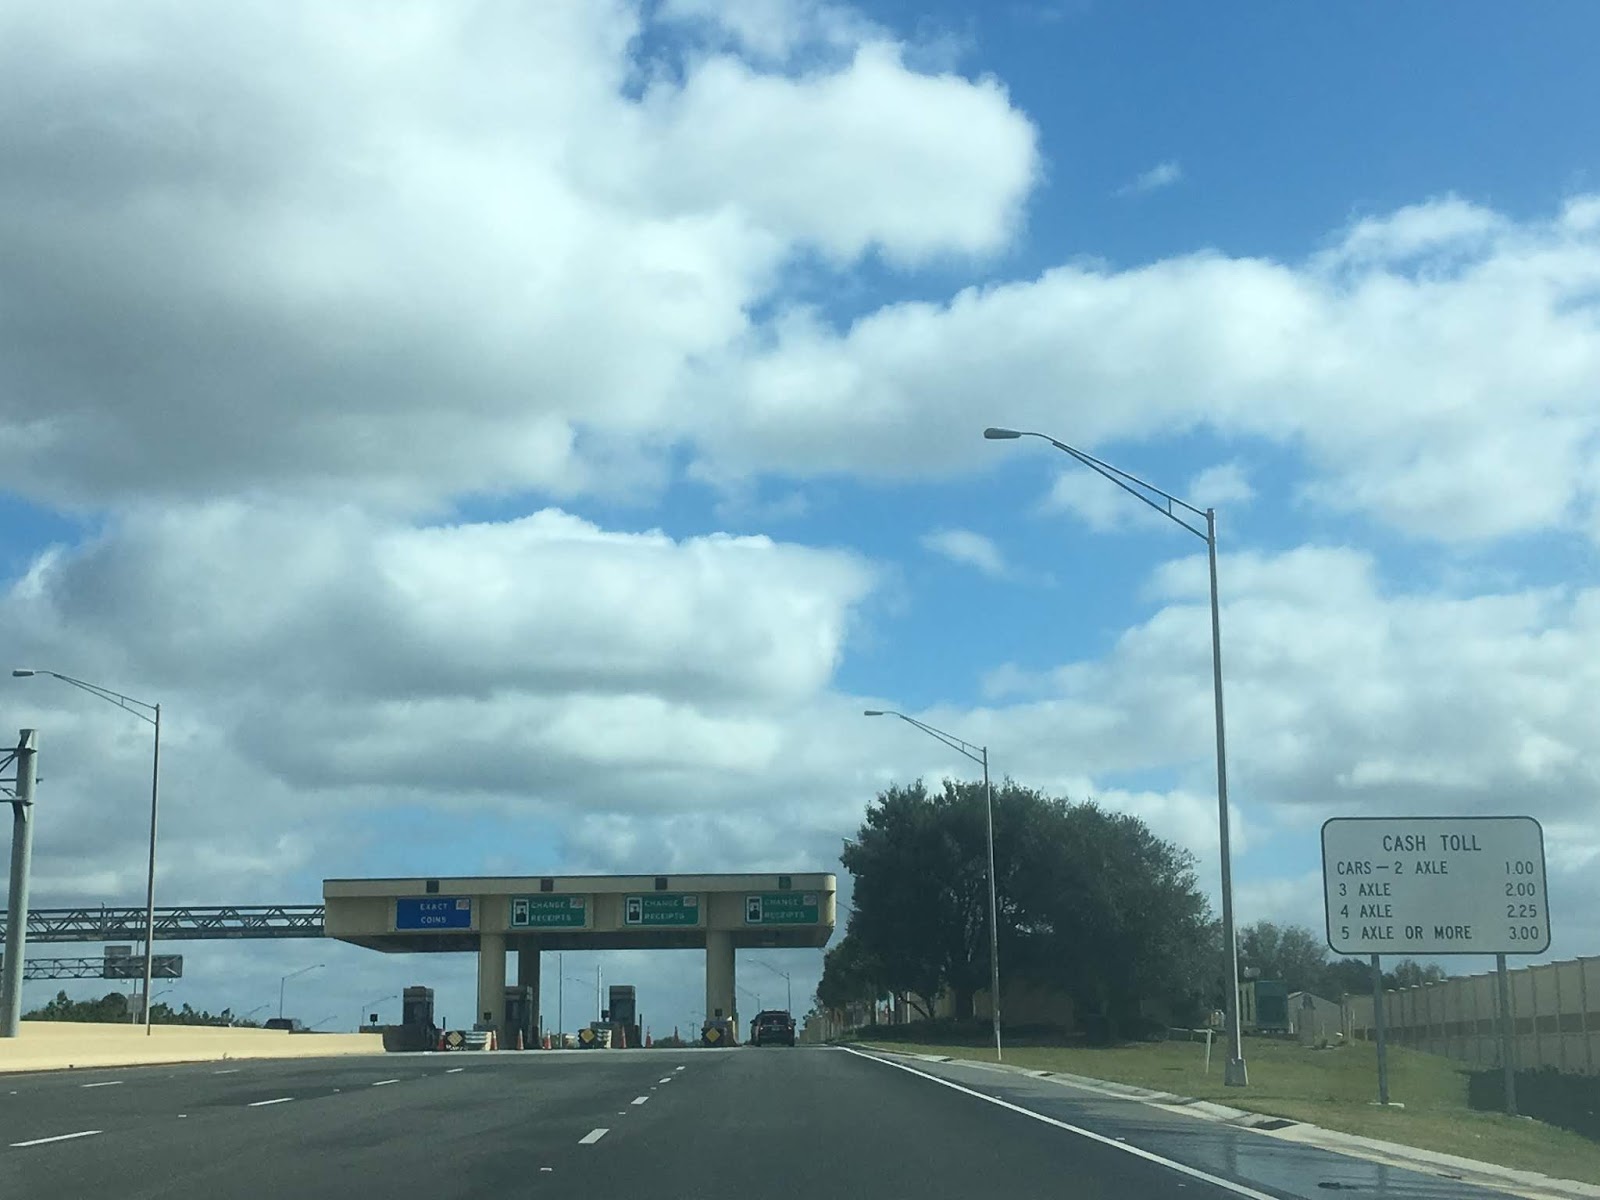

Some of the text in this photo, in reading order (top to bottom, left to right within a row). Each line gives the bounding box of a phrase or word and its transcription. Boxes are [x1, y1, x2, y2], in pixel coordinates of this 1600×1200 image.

[1382, 834, 1482, 852] CASH TOLL
[1337, 861, 1372, 875] CARS
[1415, 861, 1448, 874] AXLE
[1505, 861, 1534, 875] 1.00
[1339, 883, 1391, 896] 3 AXLE
[1505, 883, 1536, 896] 2.00
[419, 903, 448, 911] EXACT
[530, 901, 566, 909] CHANGE
[764, 898, 799, 906] CHANGE
[531, 914, 572, 922] RECEIPTS
[644, 912, 685, 921] RECEIPTS
[764, 911, 805, 919] RECEIPTS
[1340, 905, 1393, 918] 4 AXLE
[1507, 905, 1537, 918] 2.25
[420, 916, 447, 924] COINS
[1341, 926, 1473, 940] 5 AXLE OR MORE
[1508, 926, 1539, 940] 3.00
